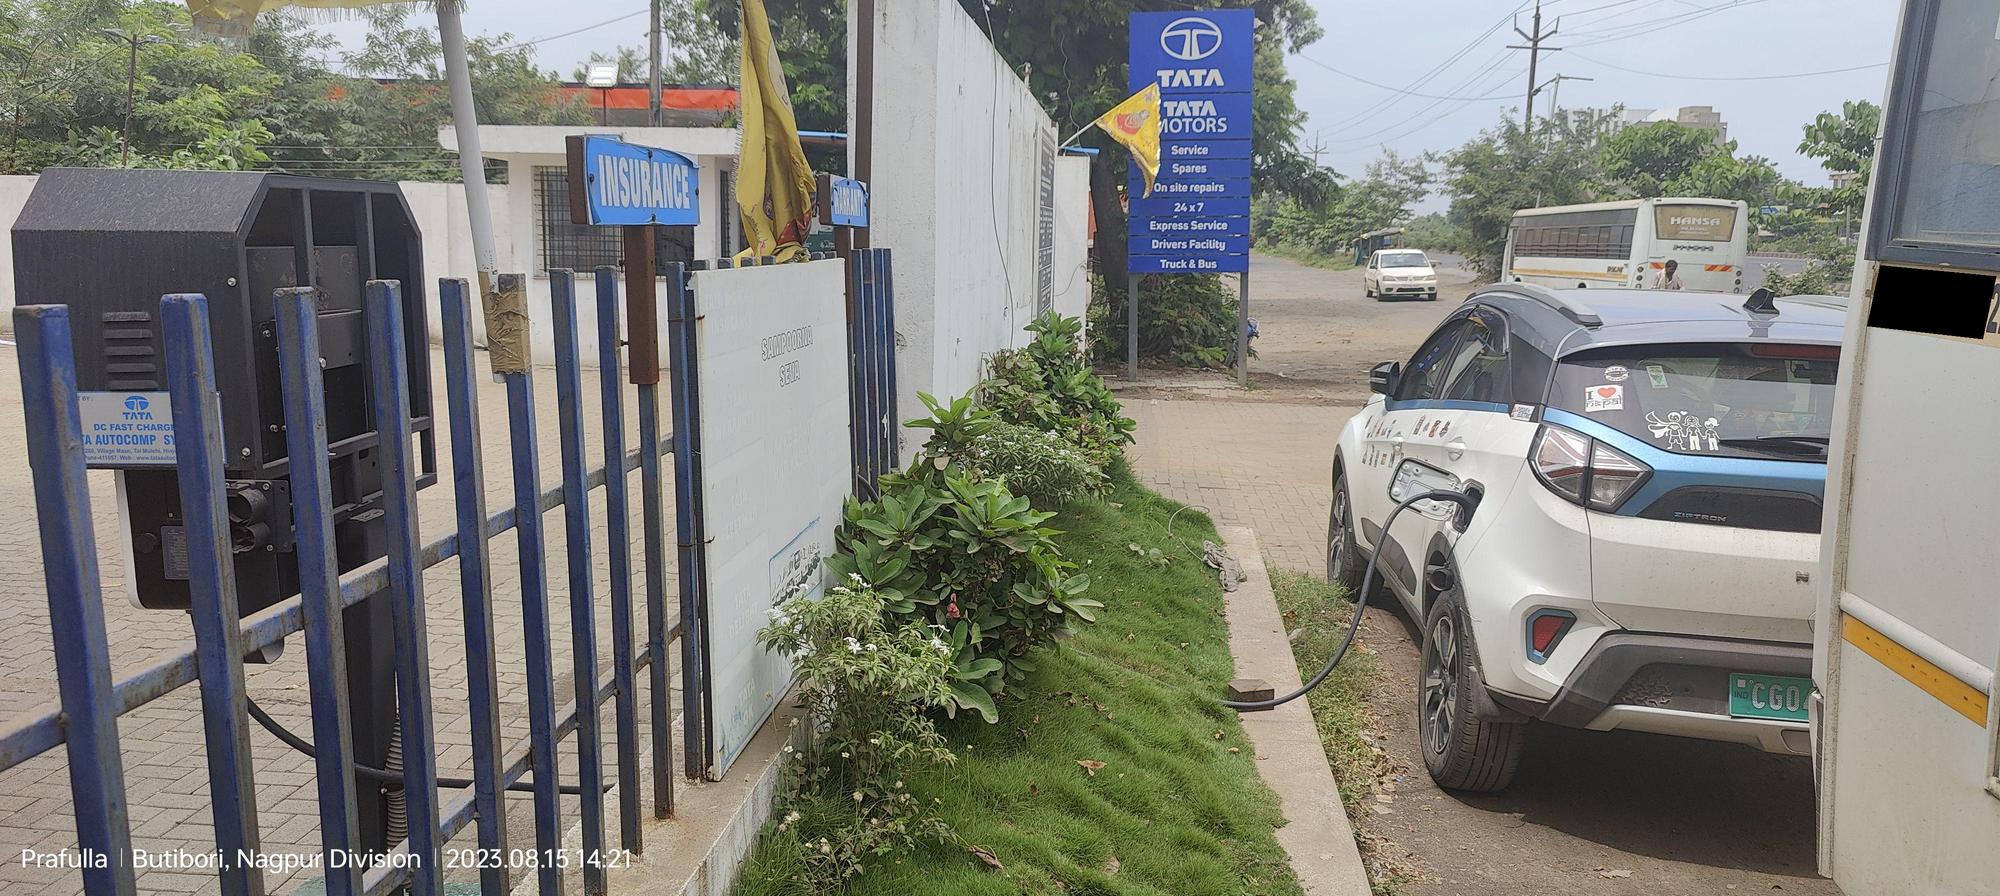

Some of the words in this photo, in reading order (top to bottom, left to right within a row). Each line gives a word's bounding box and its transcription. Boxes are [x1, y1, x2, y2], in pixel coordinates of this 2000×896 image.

[1156, 69, 1224, 87] TATA
[1163, 101, 1217, 116] TATA
[1171, 145, 1208, 155] Service
[1172, 163, 1207, 175] Spares
[598, 154, 690, 209] INSURANCE
[1154, 183, 1170, 193] On
[1171, 182, 1188, 193] site
[1189, 183, 1225, 195] repairs
[1174, 202, 1188, 212] 24
[1189, 204, 1195, 212] x
[1196, 202, 1204, 212] 7
[1670, 216, 1720, 226] HANSA
[1150, 221, 1188, 233] Express
[1190, 221, 1228, 231] Service
[1152, 239, 1187, 249] Drivers
[1189, 239, 1226, 251] Facility
[1160, 259, 1187, 269] Truck
[1188, 259, 1197, 269] &
[1198, 259, 1217, 269] Bus
[760, 325, 814, 361] SAMPOORNA
[779, 360, 800, 388] SEVA
[1585, 390, 1594, 400] I
[122, 412, 153, 420] TATA
[94, 423, 107, 431] DC
[110, 423, 133, 431] FAST
[95, 434, 157, 445] AUTOCOMP
[1672, 511, 1728, 522] ZIPTRON
[1734, 691, 1749, 700] IND
